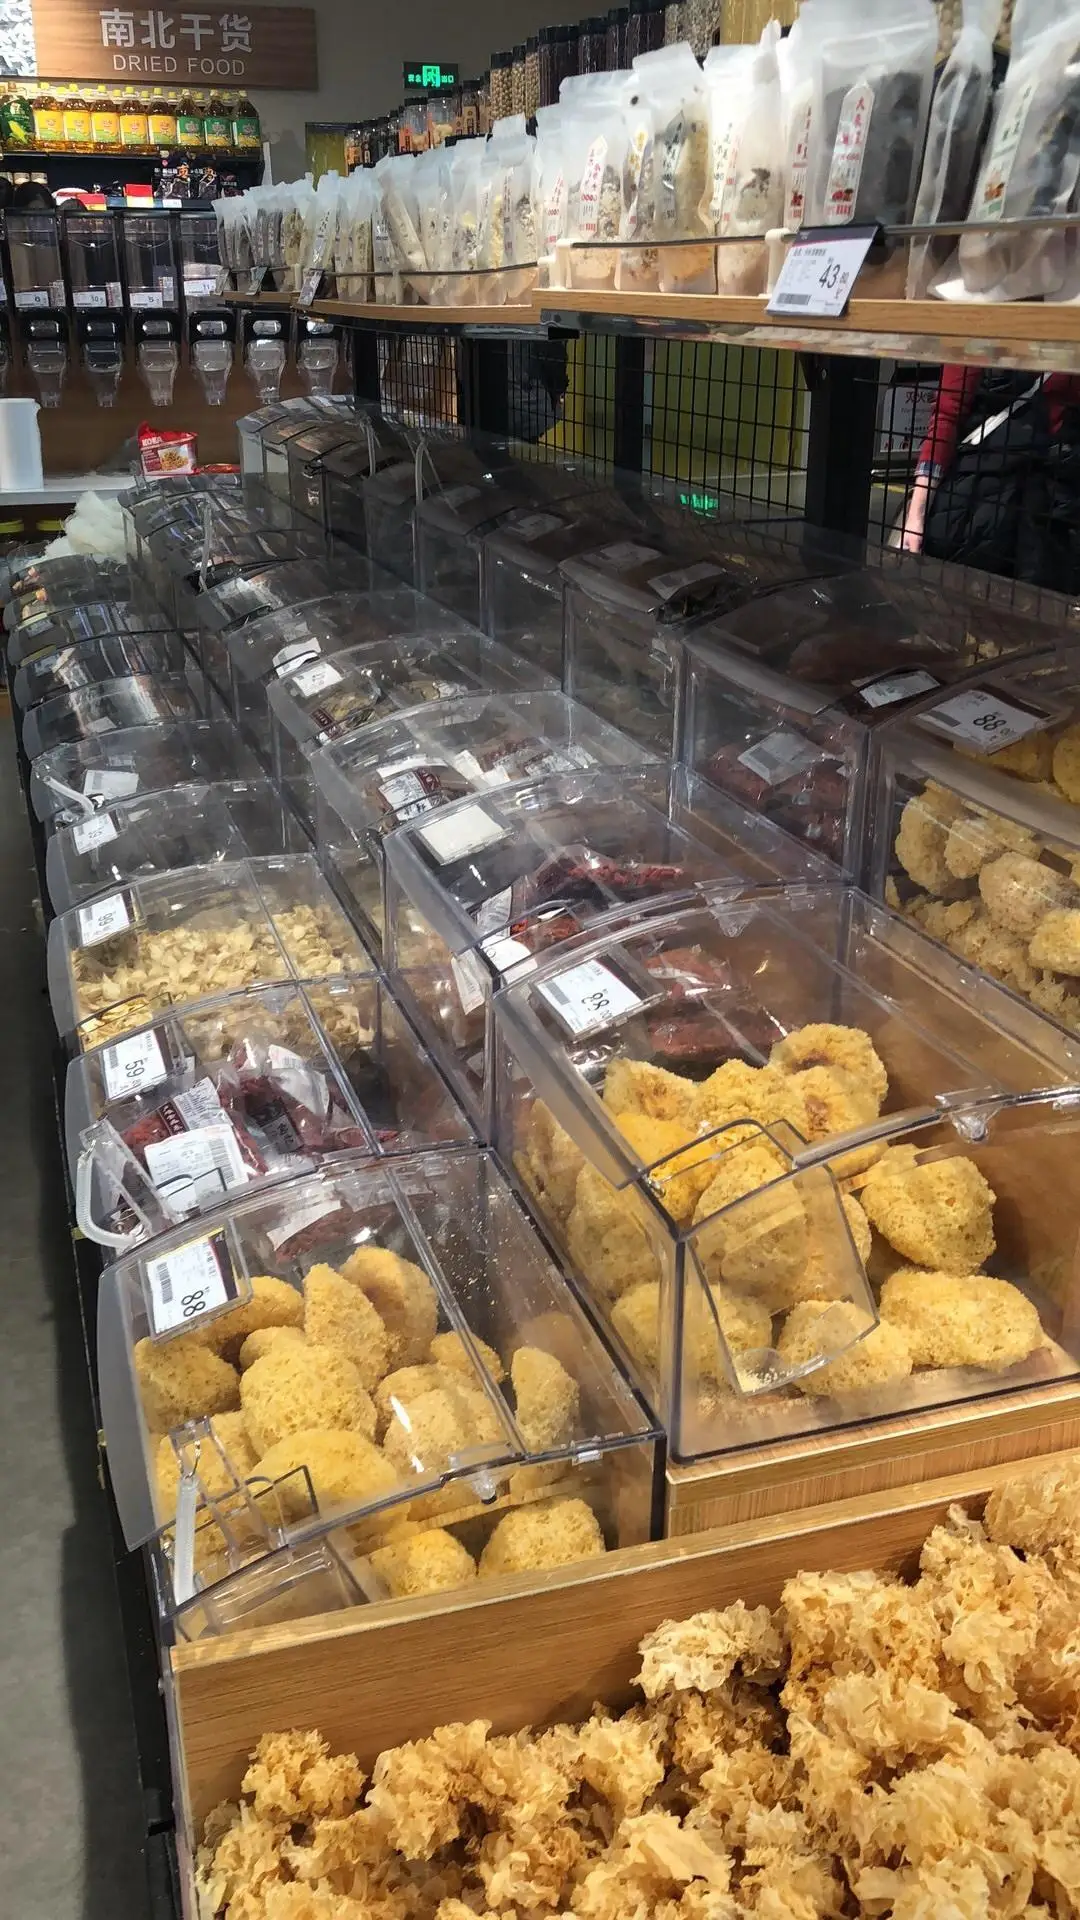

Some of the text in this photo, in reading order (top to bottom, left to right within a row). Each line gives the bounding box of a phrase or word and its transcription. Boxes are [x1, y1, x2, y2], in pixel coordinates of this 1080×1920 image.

[99, 7, 253, 53] 南北干货
[112, 54, 245, 76] DRIED FOOD
[819, 263, 841, 289] 43
[973, 713, 1007, 731] 88
[125, 1060, 145, 1078] 59
[181, 1290, 206, 1317] 88
